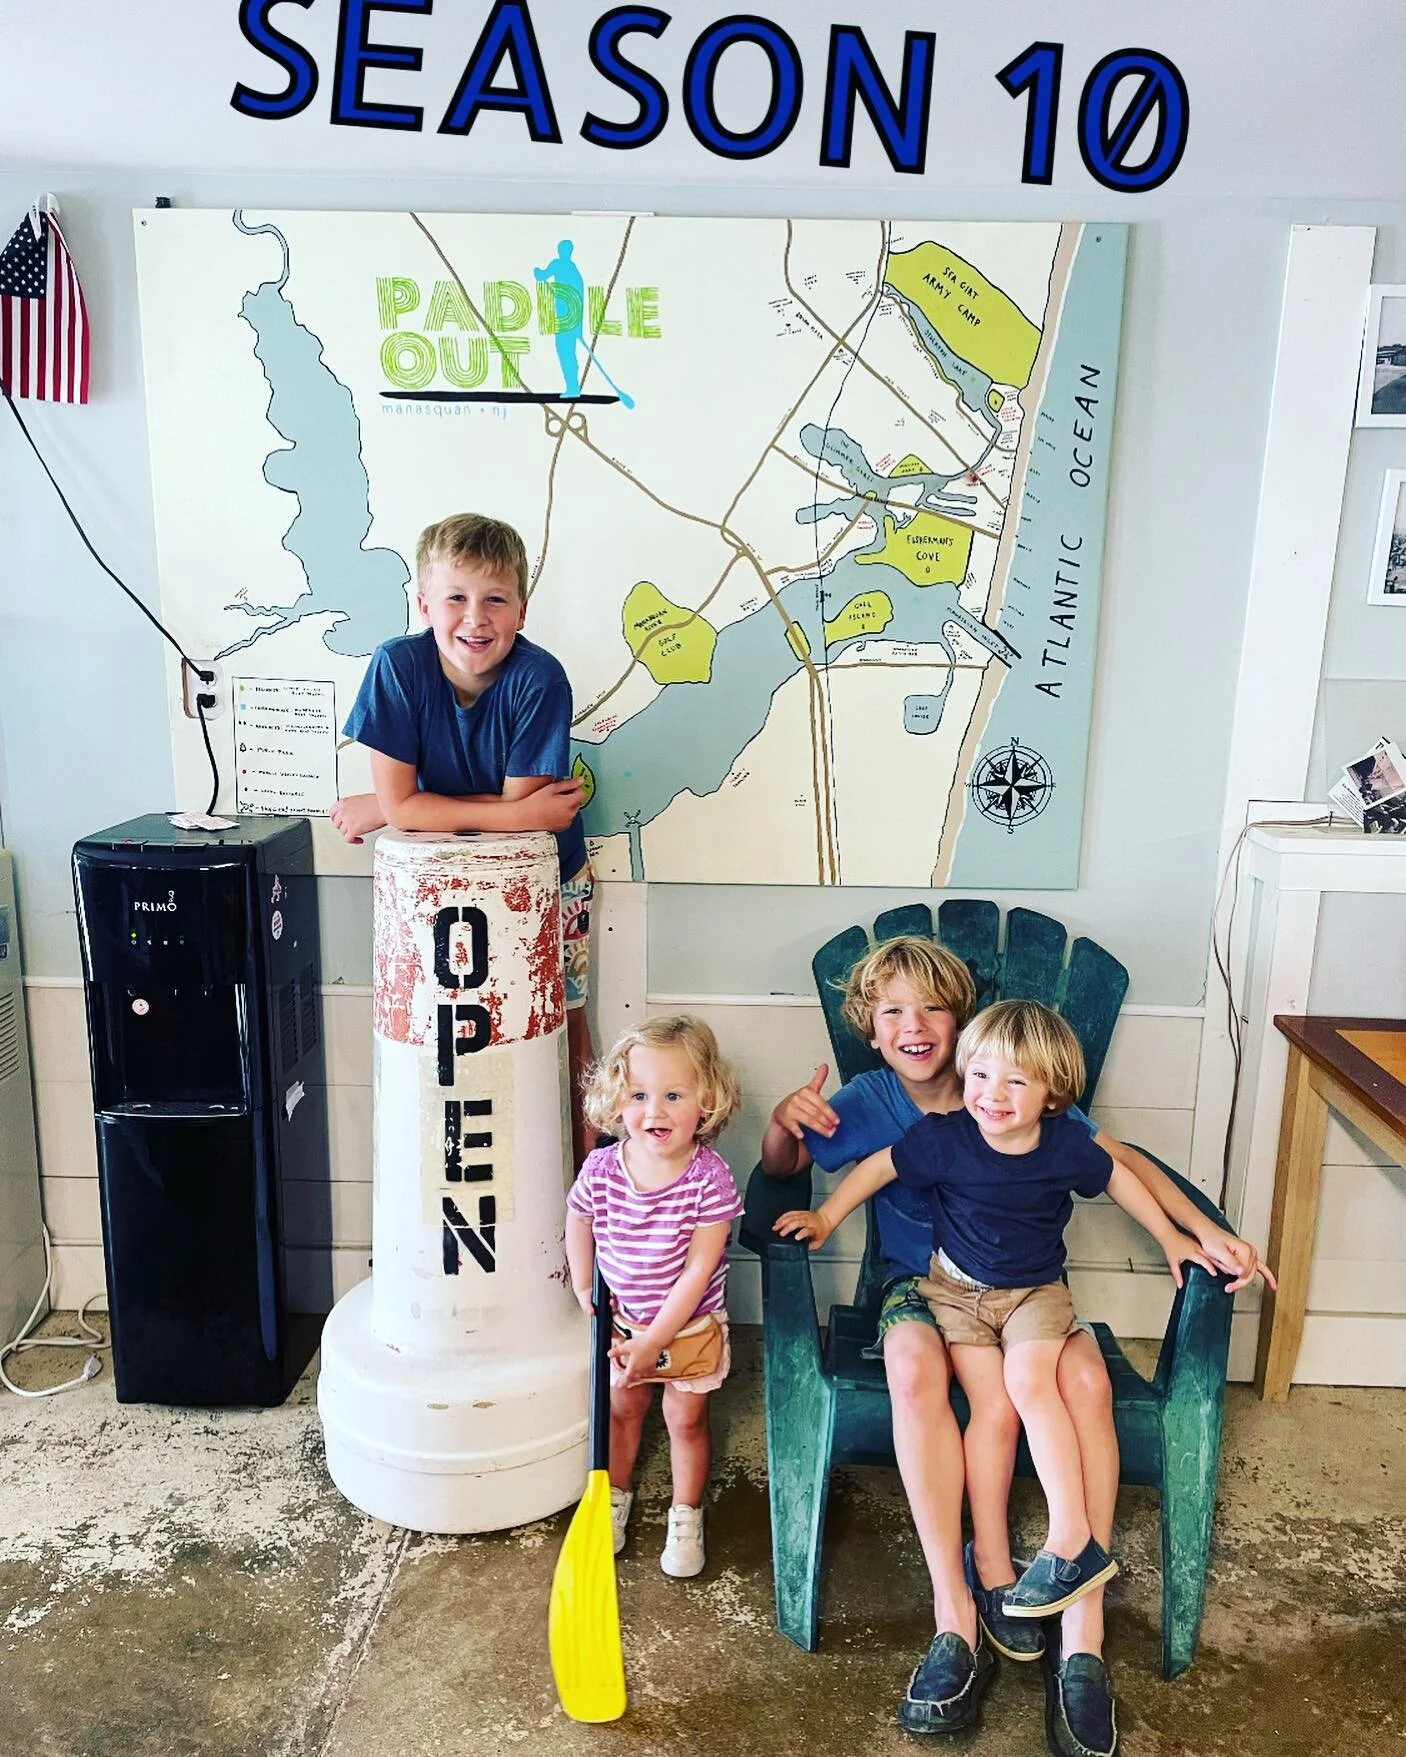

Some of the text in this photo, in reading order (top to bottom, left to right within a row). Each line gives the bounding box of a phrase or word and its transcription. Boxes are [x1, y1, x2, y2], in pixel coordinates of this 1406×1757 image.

[376, 277, 662, 339] PADDLE
[922, 273, 982, 327] ARMY CAMP
[960, 281, 980, 300] GIRT
[380, 331, 531, 389] OUT
[382, 404, 508, 421] manasquan nj
[1034, 364, 1101, 699] ATLANTIC OCEAN
[916, 551, 941, 562] COVE
[1010, 736, 1020, 746] N
[134, 901, 177, 912] PRIMO
[434, 906, 496, 1275] OPEN
